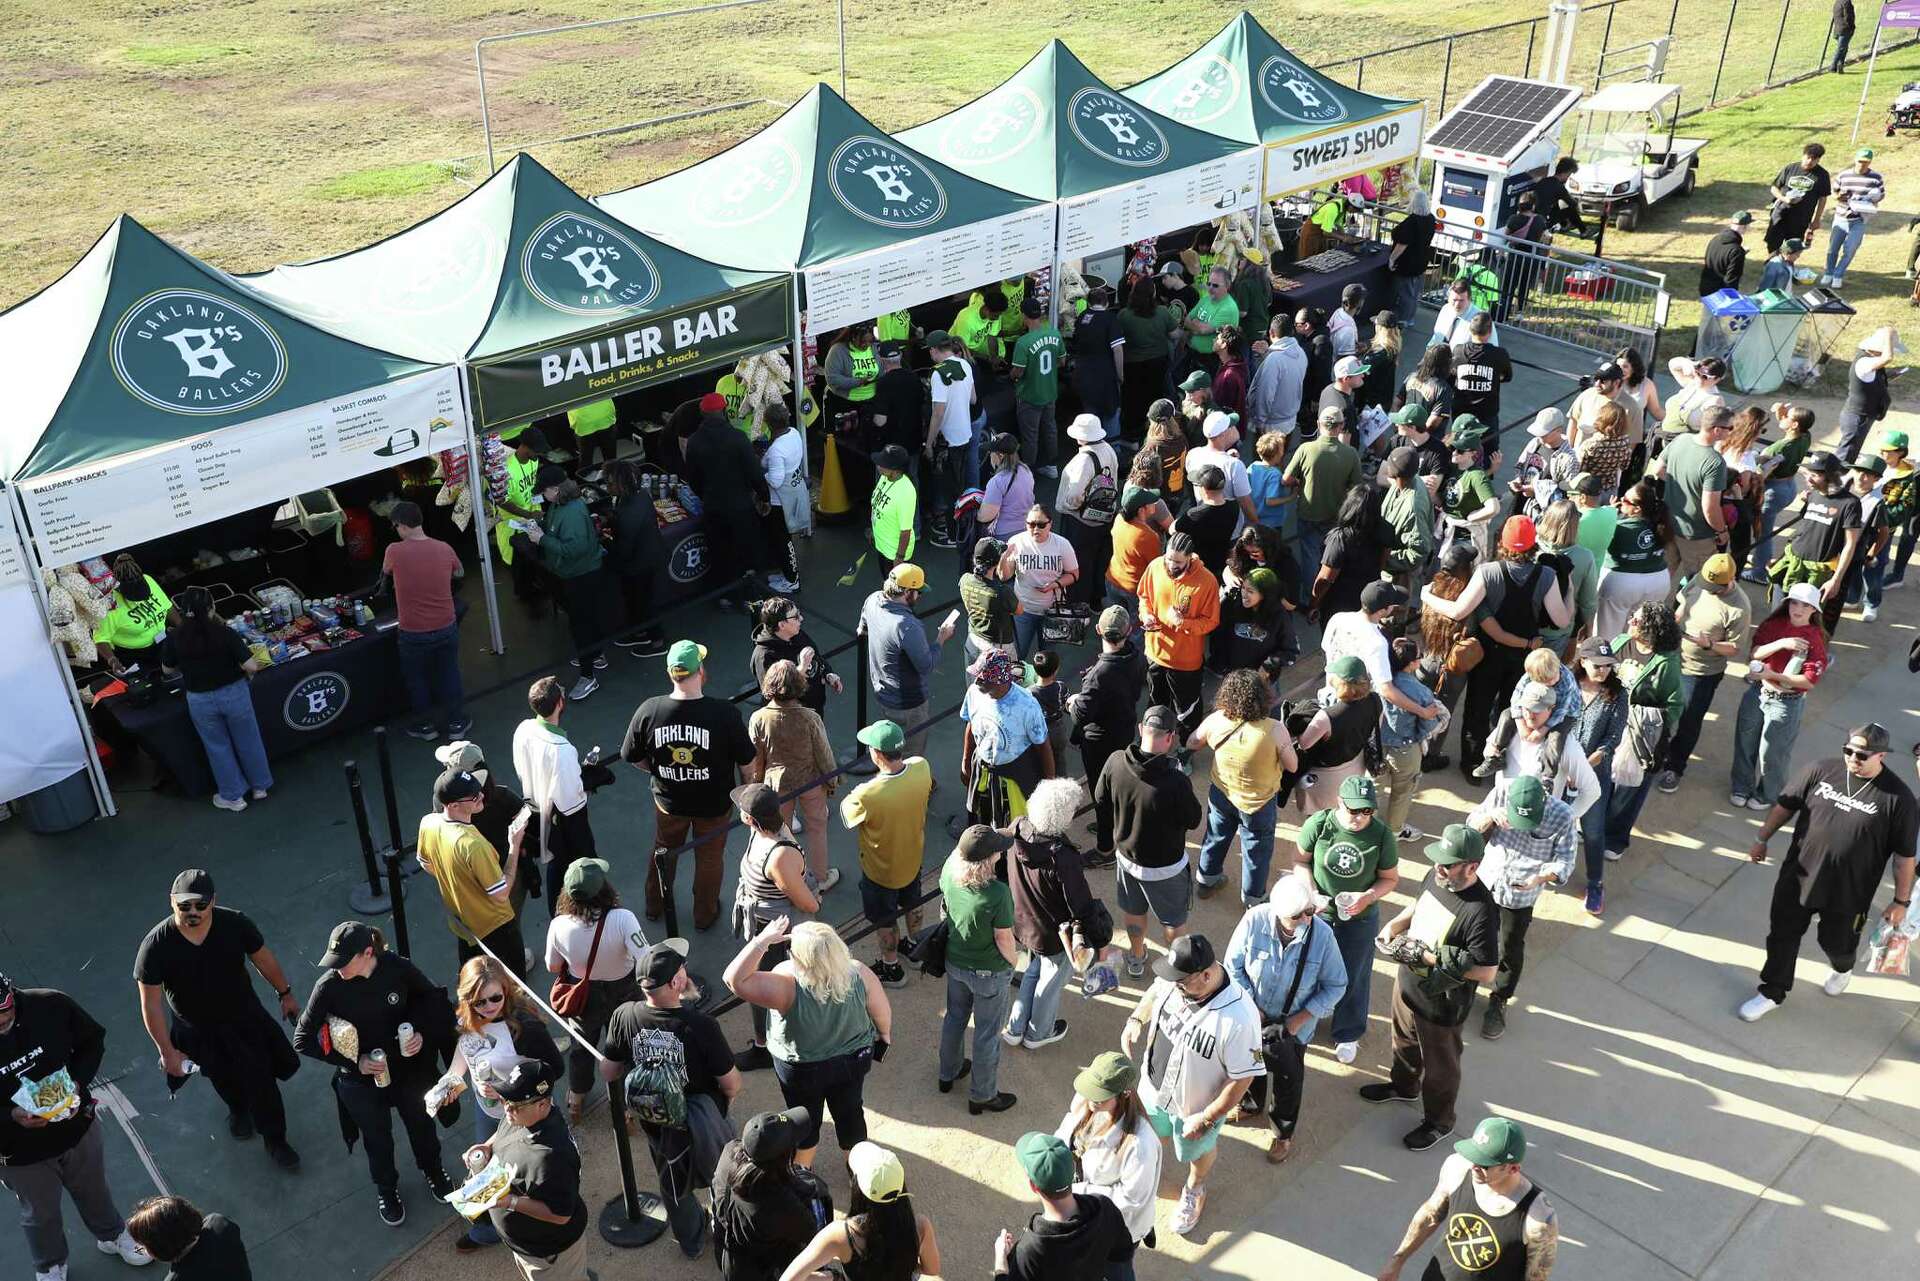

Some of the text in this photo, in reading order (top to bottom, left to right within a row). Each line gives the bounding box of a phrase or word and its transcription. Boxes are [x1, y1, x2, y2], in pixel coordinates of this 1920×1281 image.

[1081, 98, 1121, 118] OAKLAND
[1117, 140, 1156, 157] BALLERS
[1292, 136, 1349, 171] SWEET
[1354, 122, 1399, 155] SHOP
[844, 148, 896, 173] OAKLAND
[883, 197, 932, 217] BALLERS
[541, 225, 604, 260] OAKLAND
[137, 304, 224, 339] OAKLAND
[541, 304, 739, 388] BALLER BAR
[588, 350, 700, 389] Food, Drinks, & Snacks
[178, 369, 262, 400] BALLERS
[332, 394, 388, 413] BASKET COMBOS
[191, 440, 213, 451] DOGS
[34, 470, 107, 494] BALLPARK SNACKS
[655, 724, 710, 751] OAKLAND
[658, 764, 710, 782] BALLERS
